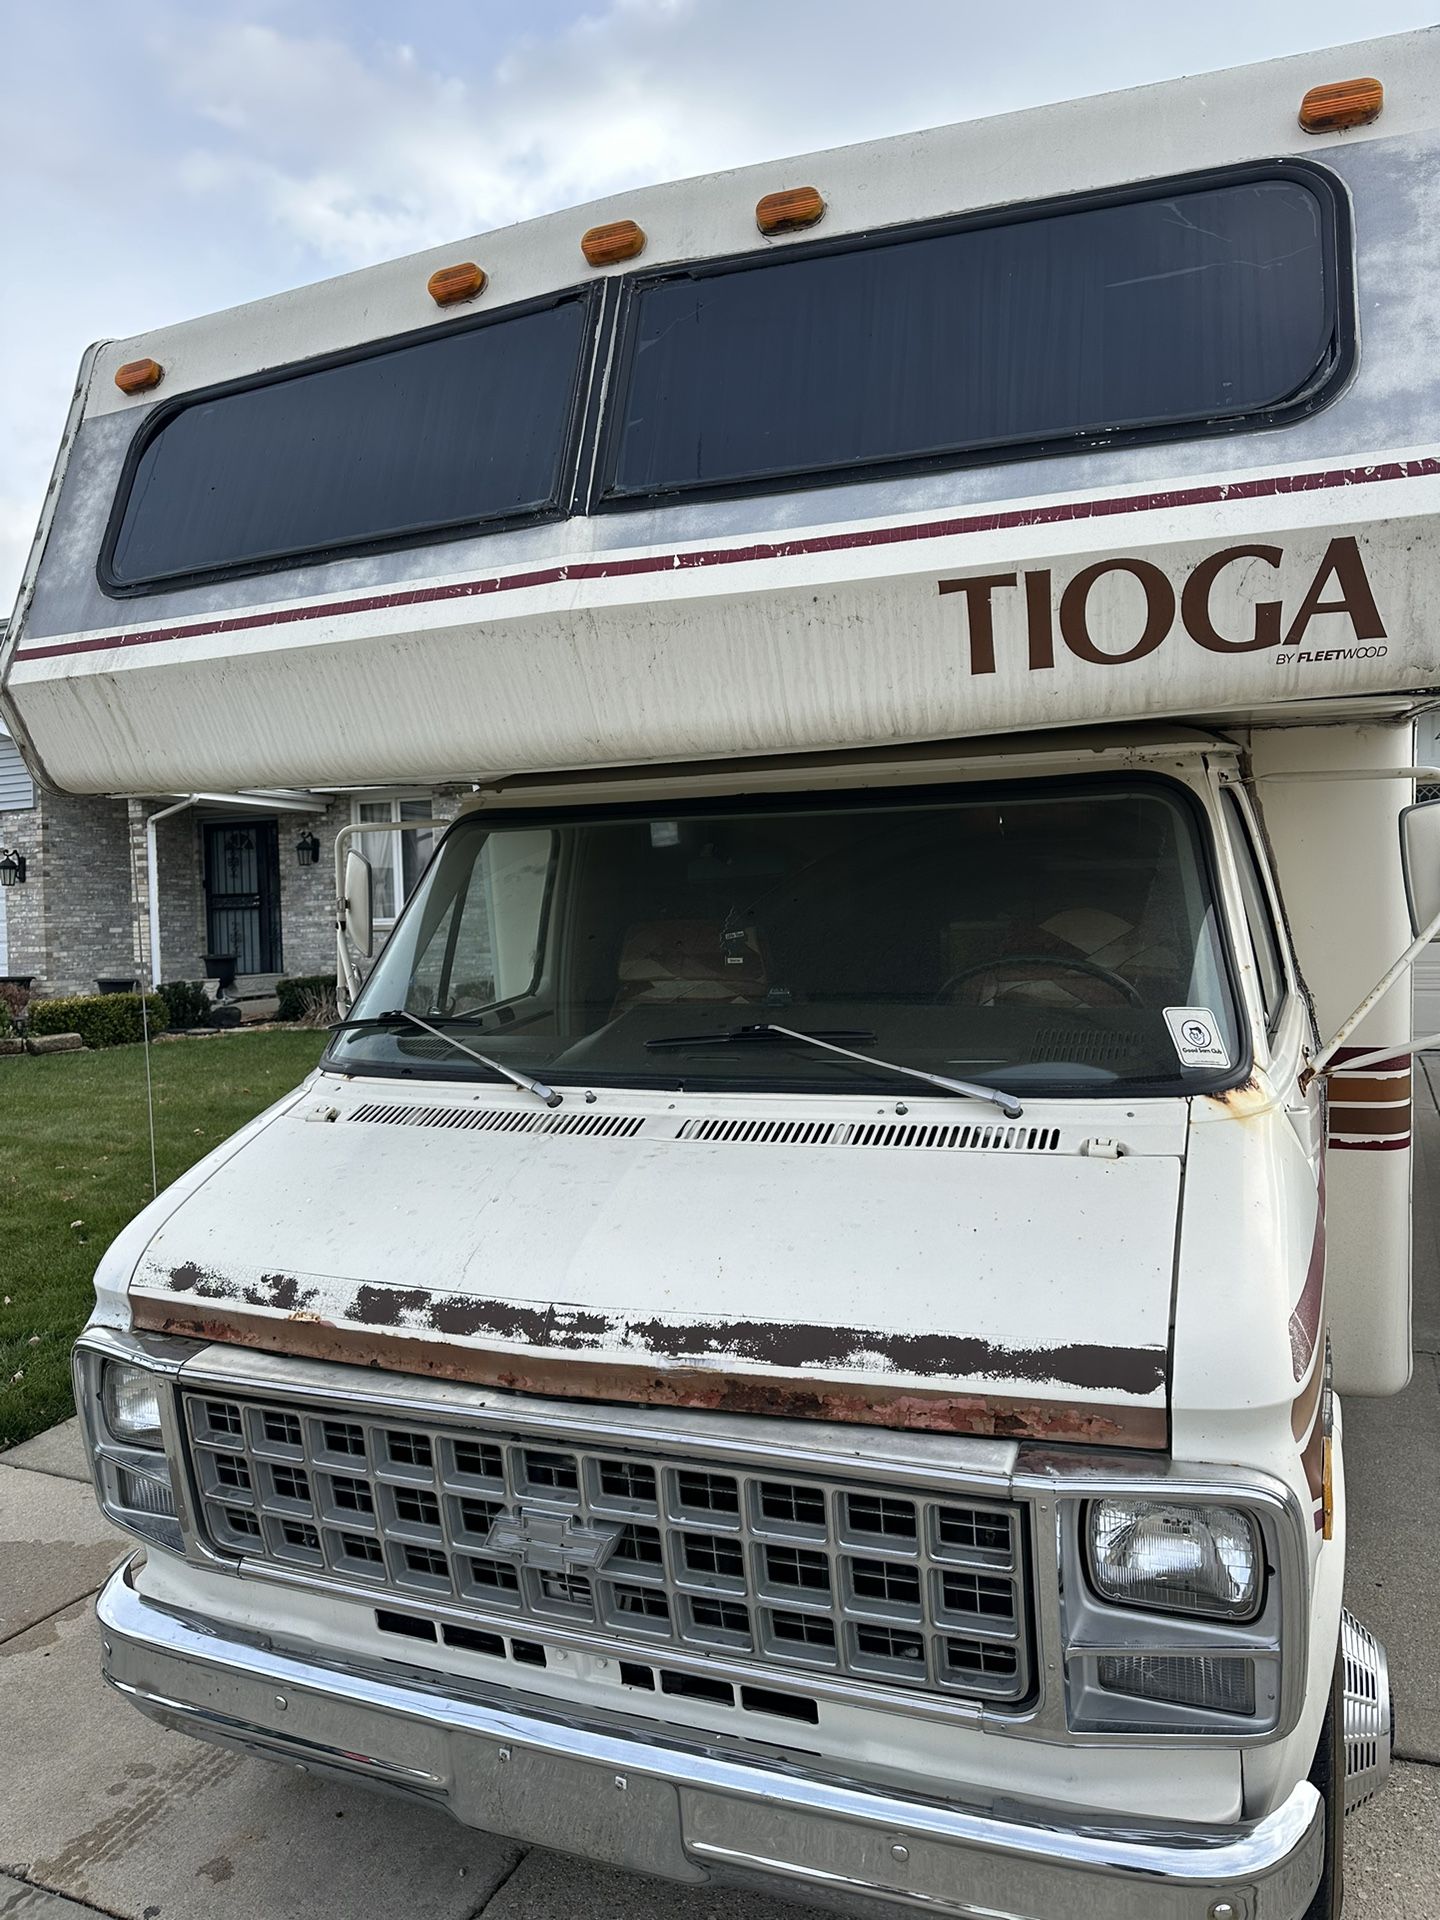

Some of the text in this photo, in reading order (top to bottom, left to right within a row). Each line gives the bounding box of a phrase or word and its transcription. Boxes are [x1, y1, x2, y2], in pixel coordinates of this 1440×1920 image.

[938, 536, 1388, 675] TIOGA
[1276, 646, 1388, 665] BY FLEETWOOD
